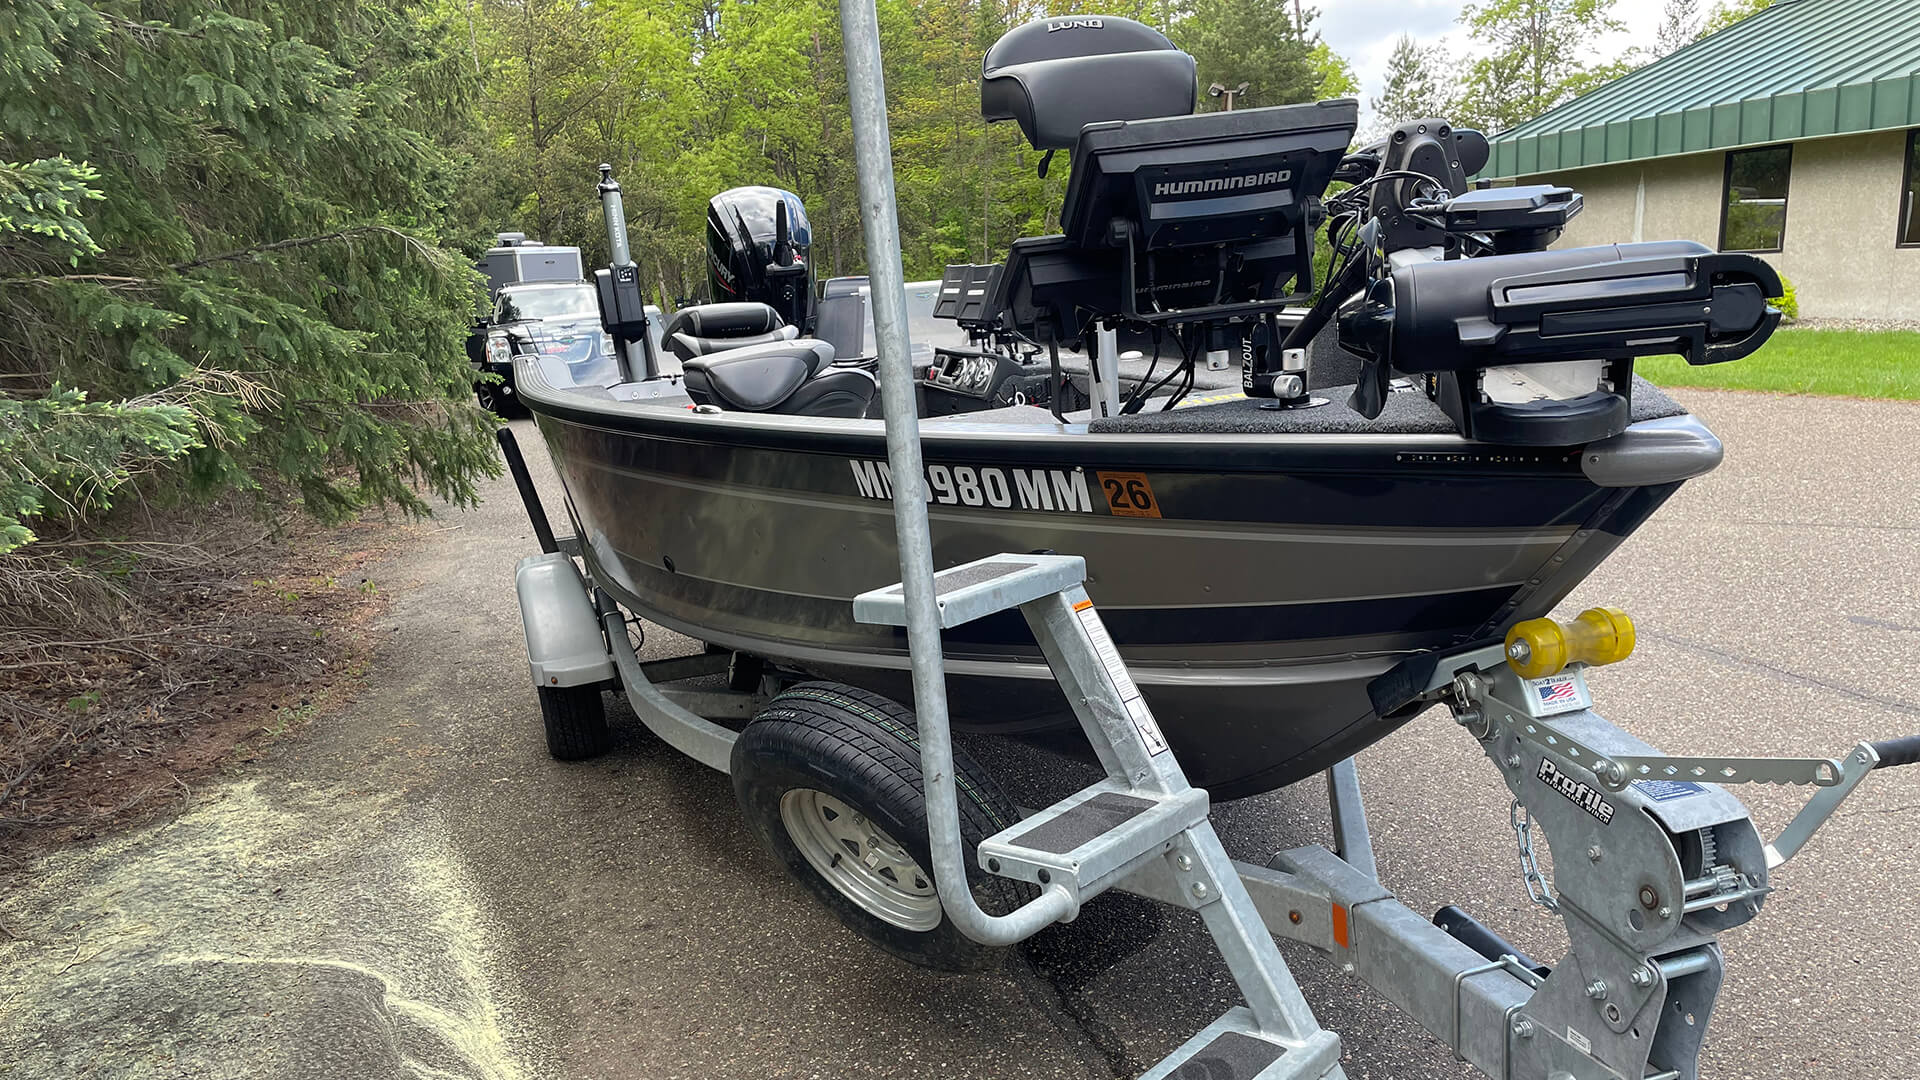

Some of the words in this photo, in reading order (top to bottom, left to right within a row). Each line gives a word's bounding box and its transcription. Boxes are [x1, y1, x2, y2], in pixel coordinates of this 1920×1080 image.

[1047, 19, 1104, 33] LUND
[1155, 170, 1291, 195] HUMMINBIRD
[1135, 279, 1211, 293] UMMINBIRD
[1242, 337, 1253, 388] BALZOUT
[1012, 468, 1093, 512] MM
[1104, 479, 1151, 510] 26
[1538, 773, 1584, 807] PERFORMANCE
[1585, 804, 1609, 824] WINCH
[1540, 758, 1614, 819] Profile
